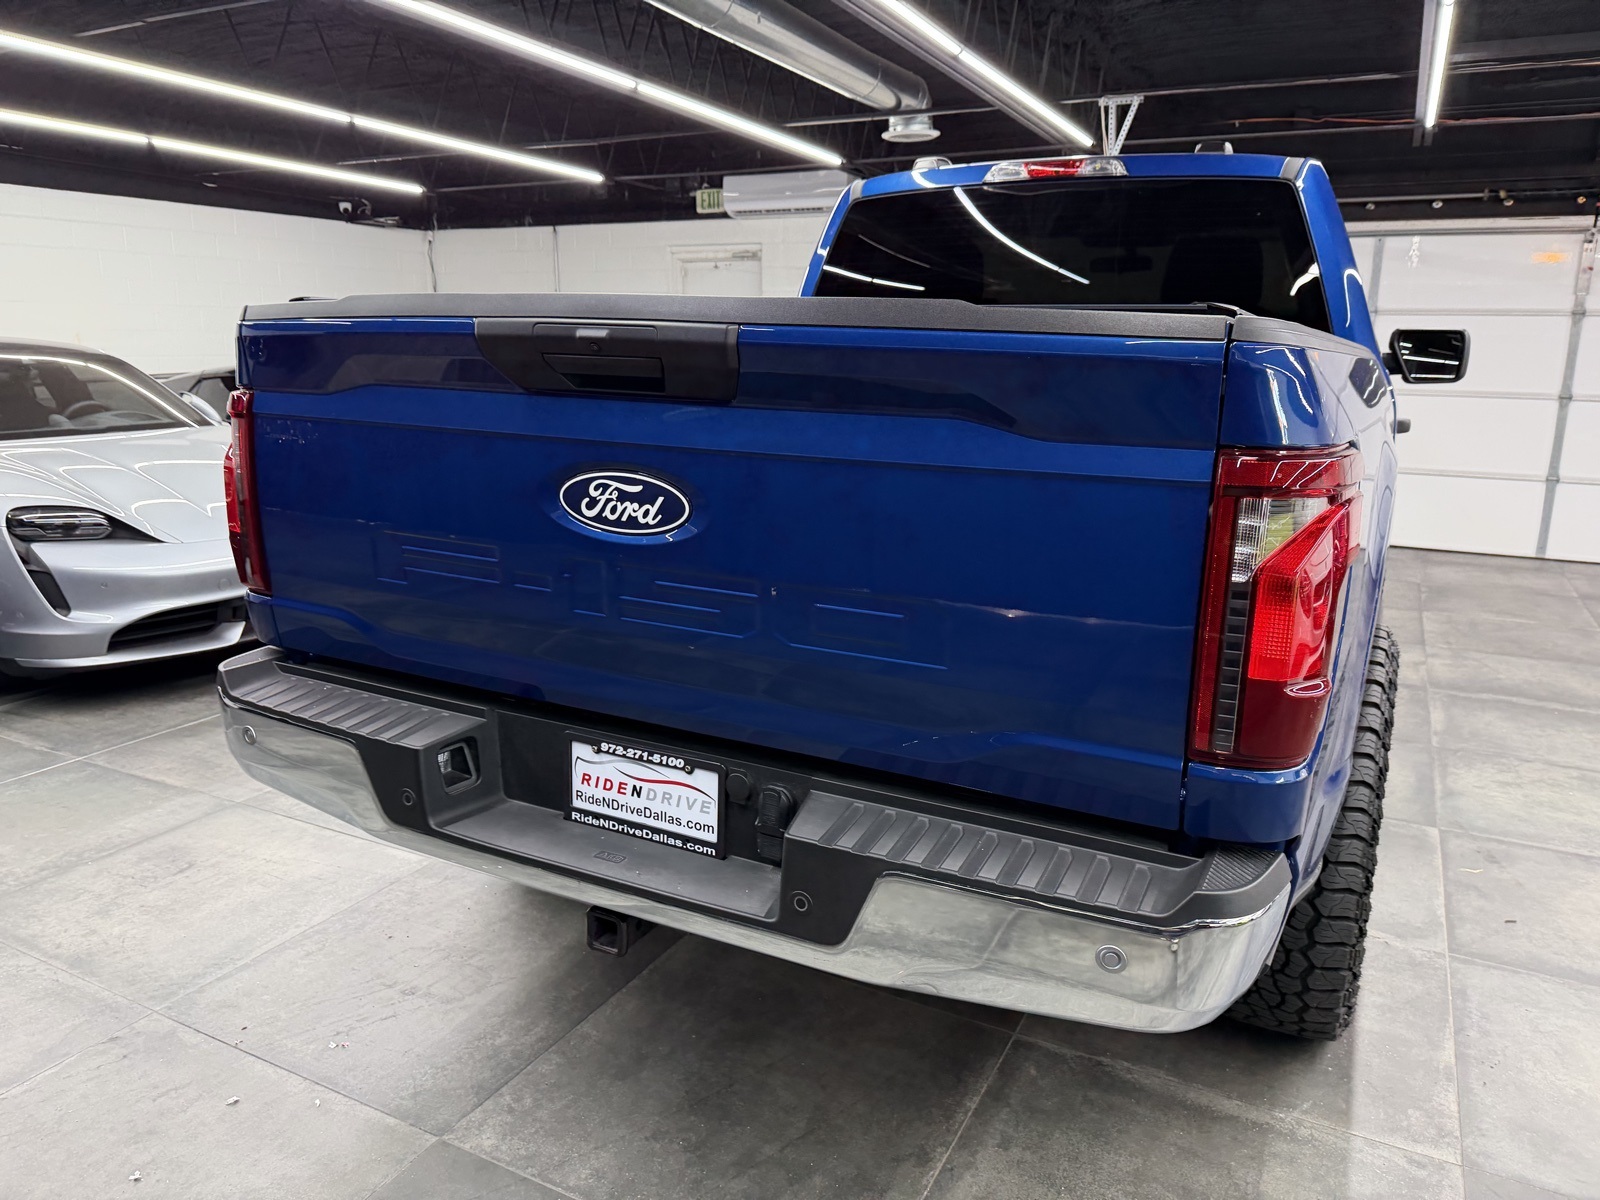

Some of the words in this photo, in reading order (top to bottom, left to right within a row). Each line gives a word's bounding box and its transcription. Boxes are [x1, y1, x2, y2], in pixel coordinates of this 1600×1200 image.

[701, 191, 721, 210] EXIT
[580, 478, 665, 526] Ford
[600, 742, 685, 769] 972-271-5100
[571, 811, 716, 856] RideNDriveDallas.com
[575, 789, 715, 834] RideNDriveDallas.com
